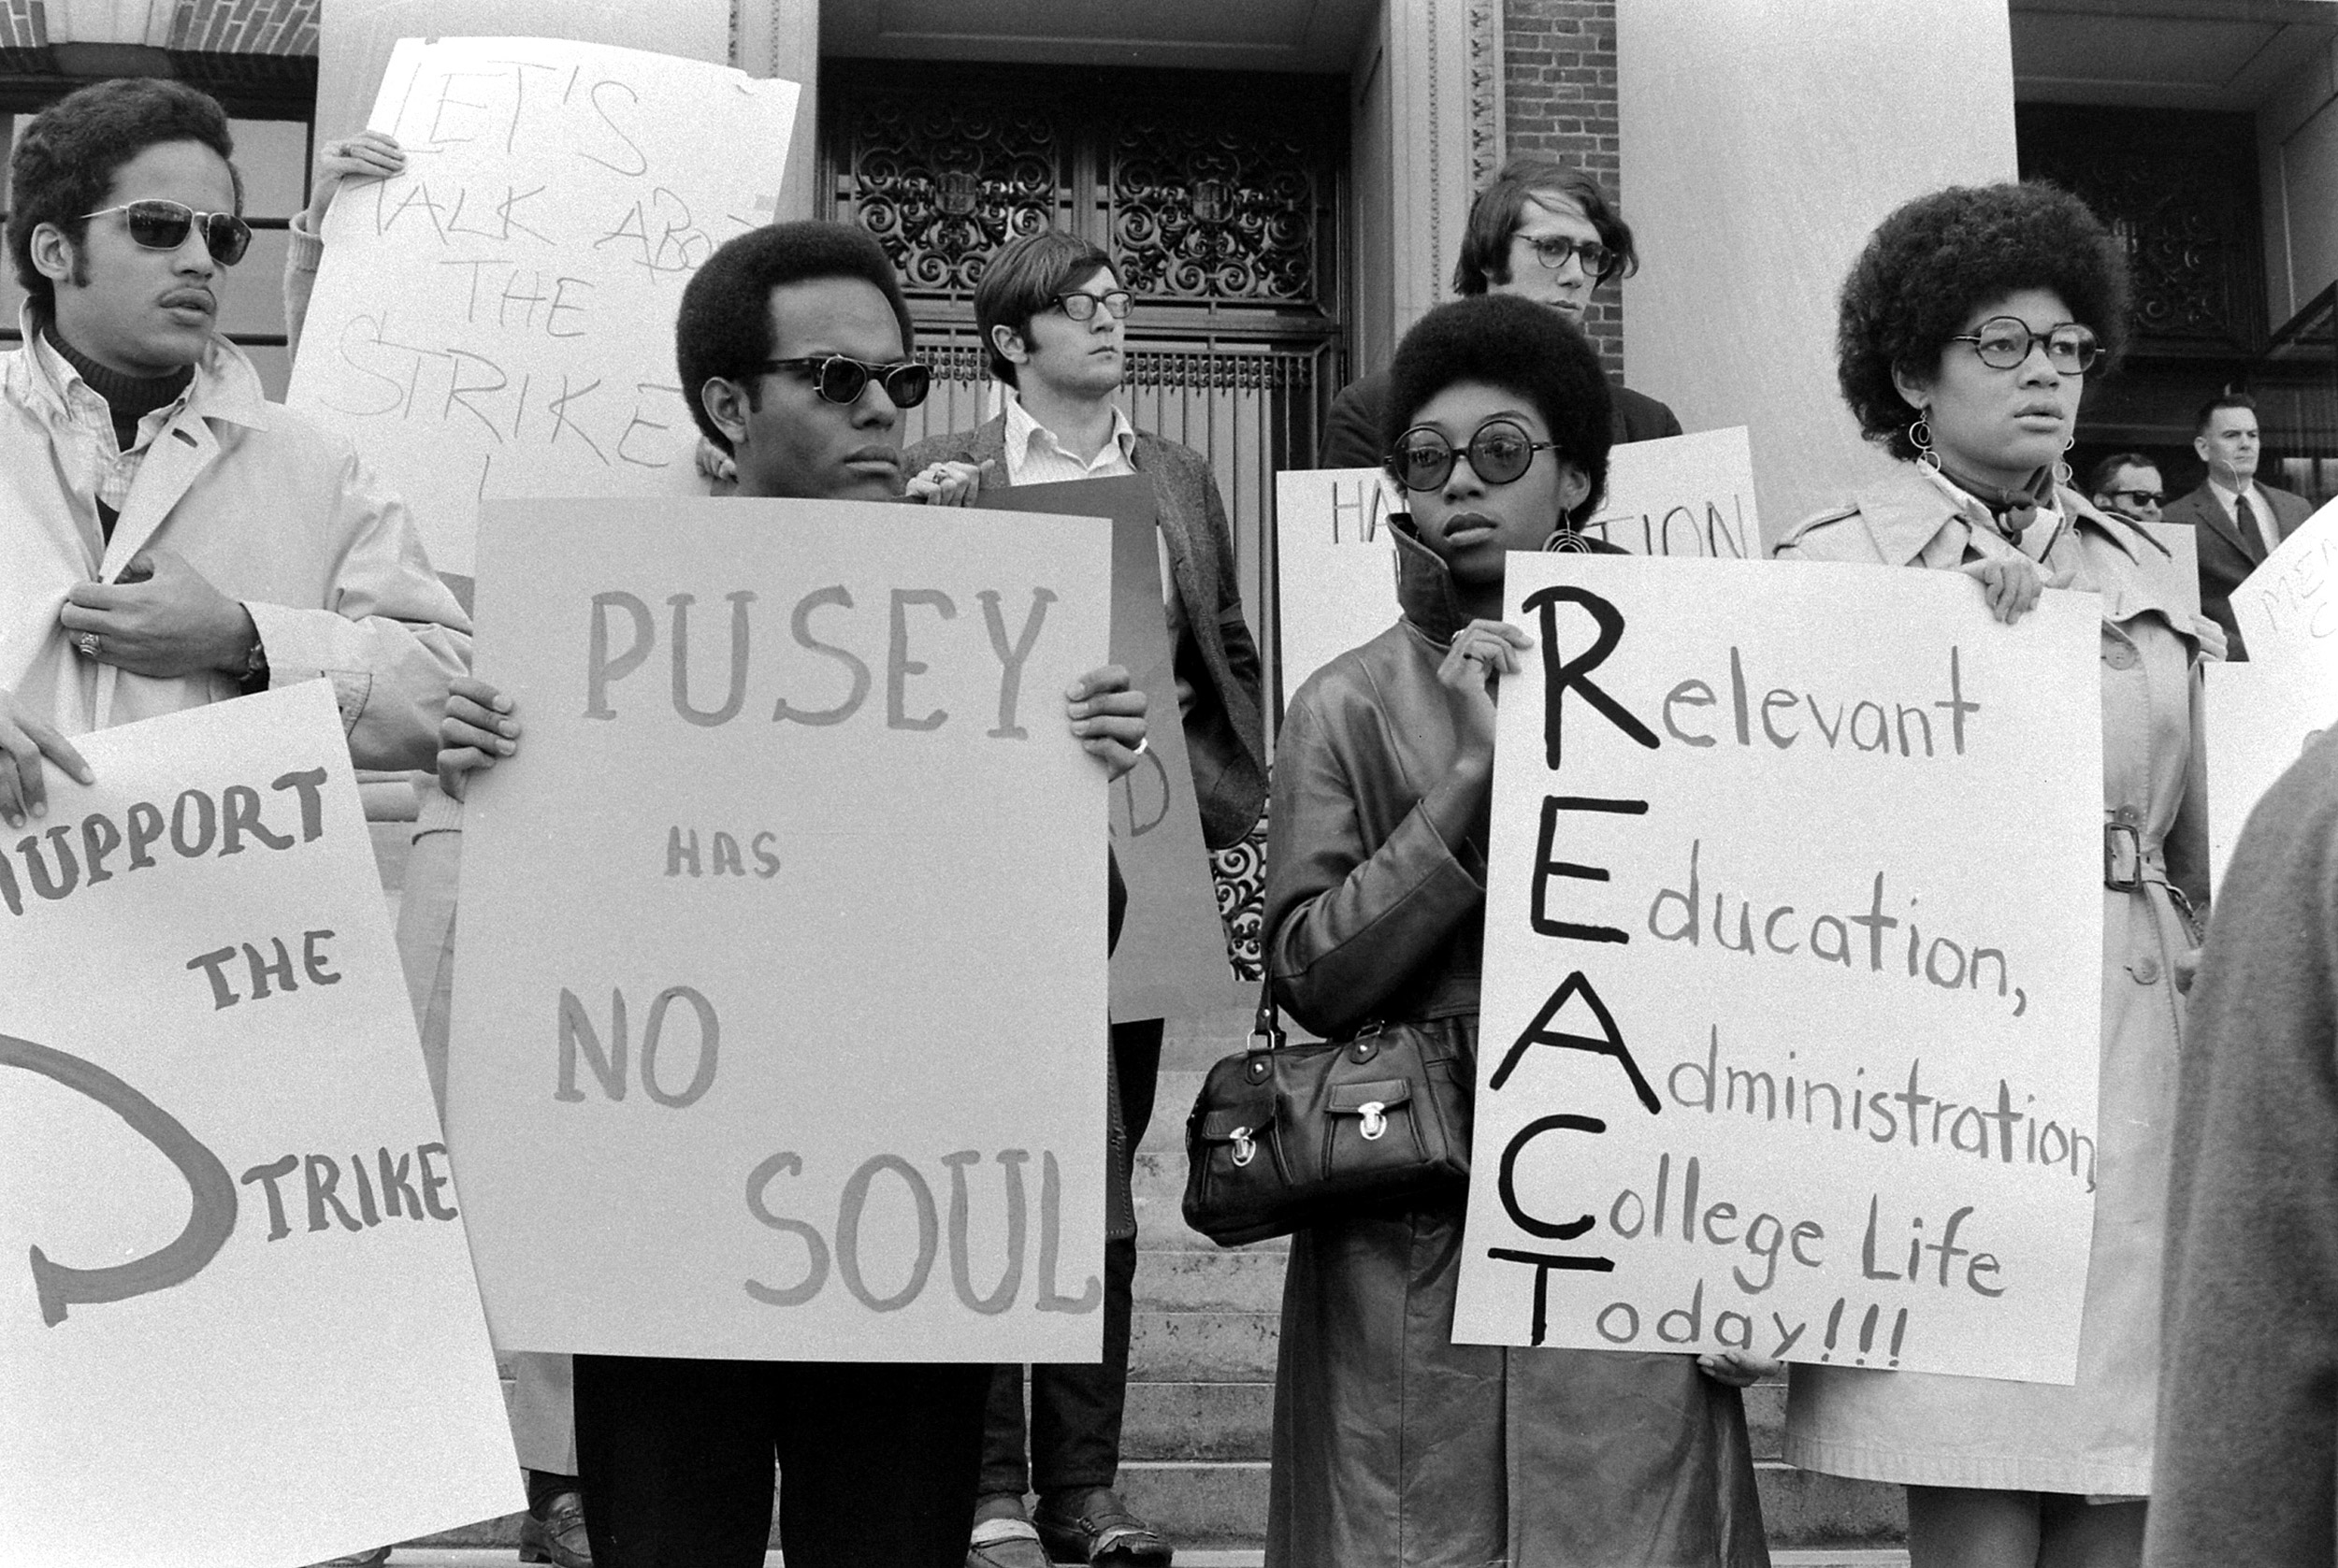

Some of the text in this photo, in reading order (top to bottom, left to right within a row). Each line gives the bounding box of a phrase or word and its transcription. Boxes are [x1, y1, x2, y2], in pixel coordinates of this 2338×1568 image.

[391, 59, 648, 178] LET'S
[376, 177, 759, 285] TALK ABO
[439, 259, 595, 337] THE
[319, 310, 683, 468] STRIKE
[581, 583, 1059, 741] PUSEY
[1521, 585, 1982, 770] Relevant
[663, 825, 782, 879] HAS
[1529, 794, 2027, 1017] Education,
[186, 928, 342, 1011] THE
[553, 985, 720, 1109] NO
[1489, 970, 2097, 1194] Administration,
[743, 1148, 1103, 1316] SOUL
[1497, 1113, 2007, 1299] College Life
[1486, 1246, 1909, 1368] Today!!!
